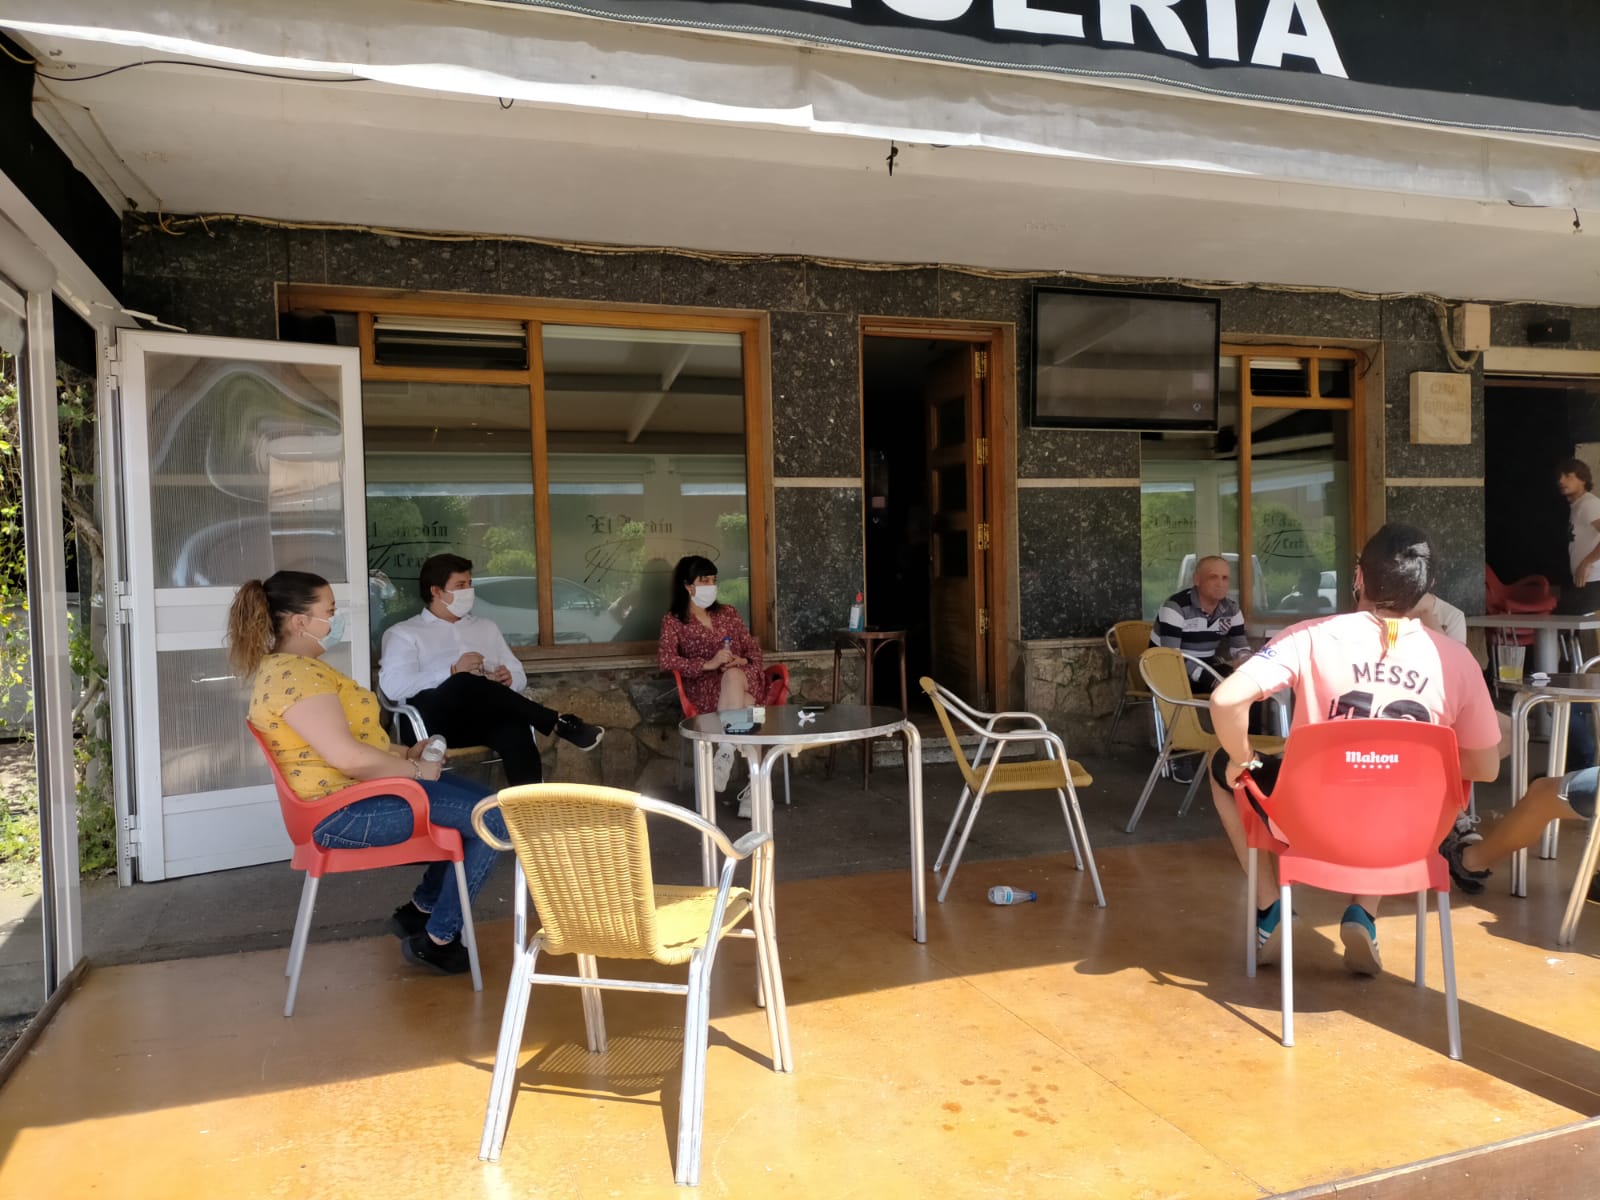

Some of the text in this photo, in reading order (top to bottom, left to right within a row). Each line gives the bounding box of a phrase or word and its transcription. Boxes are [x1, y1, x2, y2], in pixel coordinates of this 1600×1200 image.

[585, 514, 673, 535] El Jdín
[1352, 662, 1429, 695] MESSI
[1345, 751, 1399, 764] Mahou
